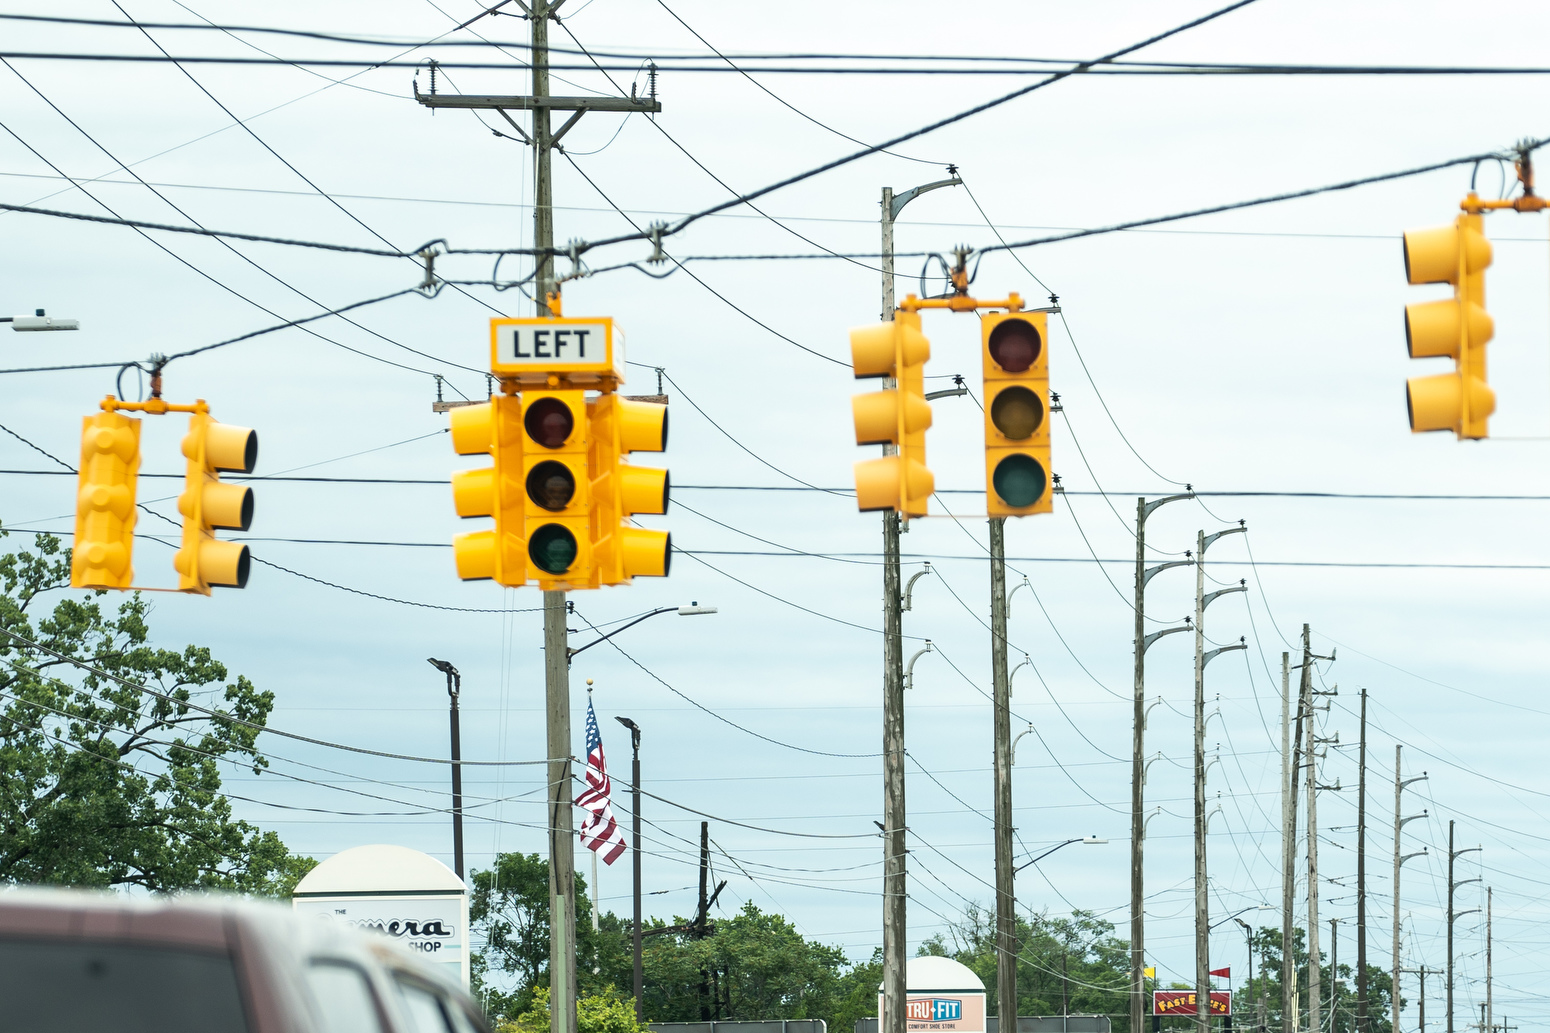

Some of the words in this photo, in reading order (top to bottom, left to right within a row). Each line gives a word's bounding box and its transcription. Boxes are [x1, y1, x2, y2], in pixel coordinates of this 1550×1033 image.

[514, 330, 590, 358] LEFT
[408, 942, 442, 953] SHOP
[937, 1002, 958, 1018] FIT
